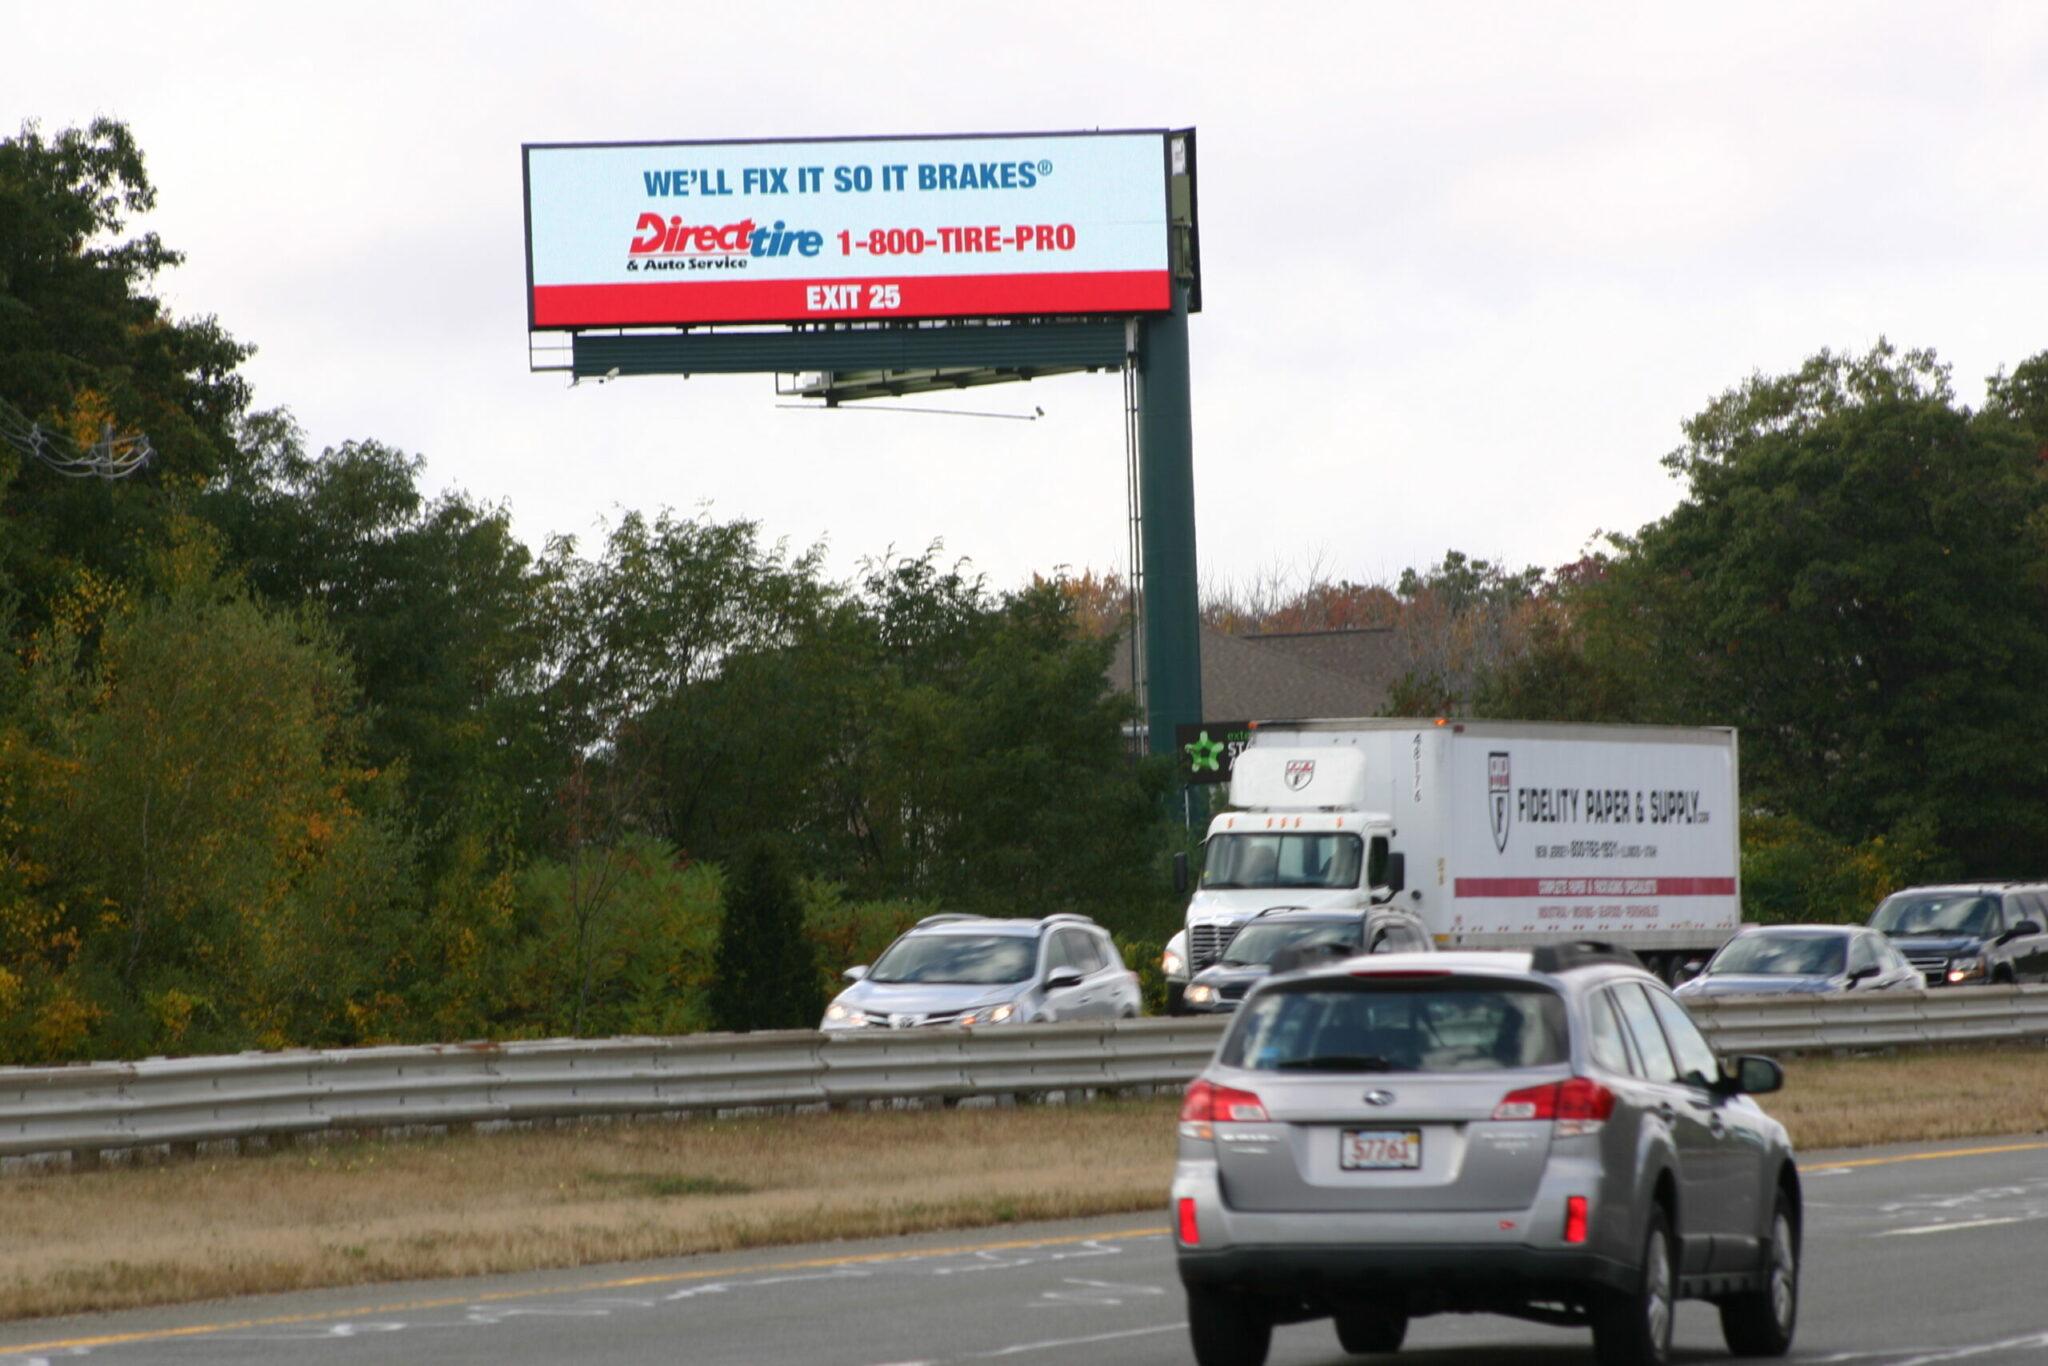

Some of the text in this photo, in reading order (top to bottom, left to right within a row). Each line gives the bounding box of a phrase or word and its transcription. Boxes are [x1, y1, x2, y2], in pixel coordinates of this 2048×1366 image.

[742, 167, 789, 195] FIX
[798, 166, 825, 193] IT
[834, 165, 873, 192] SO
[882, 164, 908, 191] IT
[836, 223, 1076, 257] 1-800-TIRE-PRO
[627, 255, 748, 271] & Auto Service
[806, 283, 901, 311] EXIT 25
[1518, 787, 1579, 823] FIDELITY
[1586, 788, 1630, 824] PAPER
[1635, 790, 1644, 824] &
